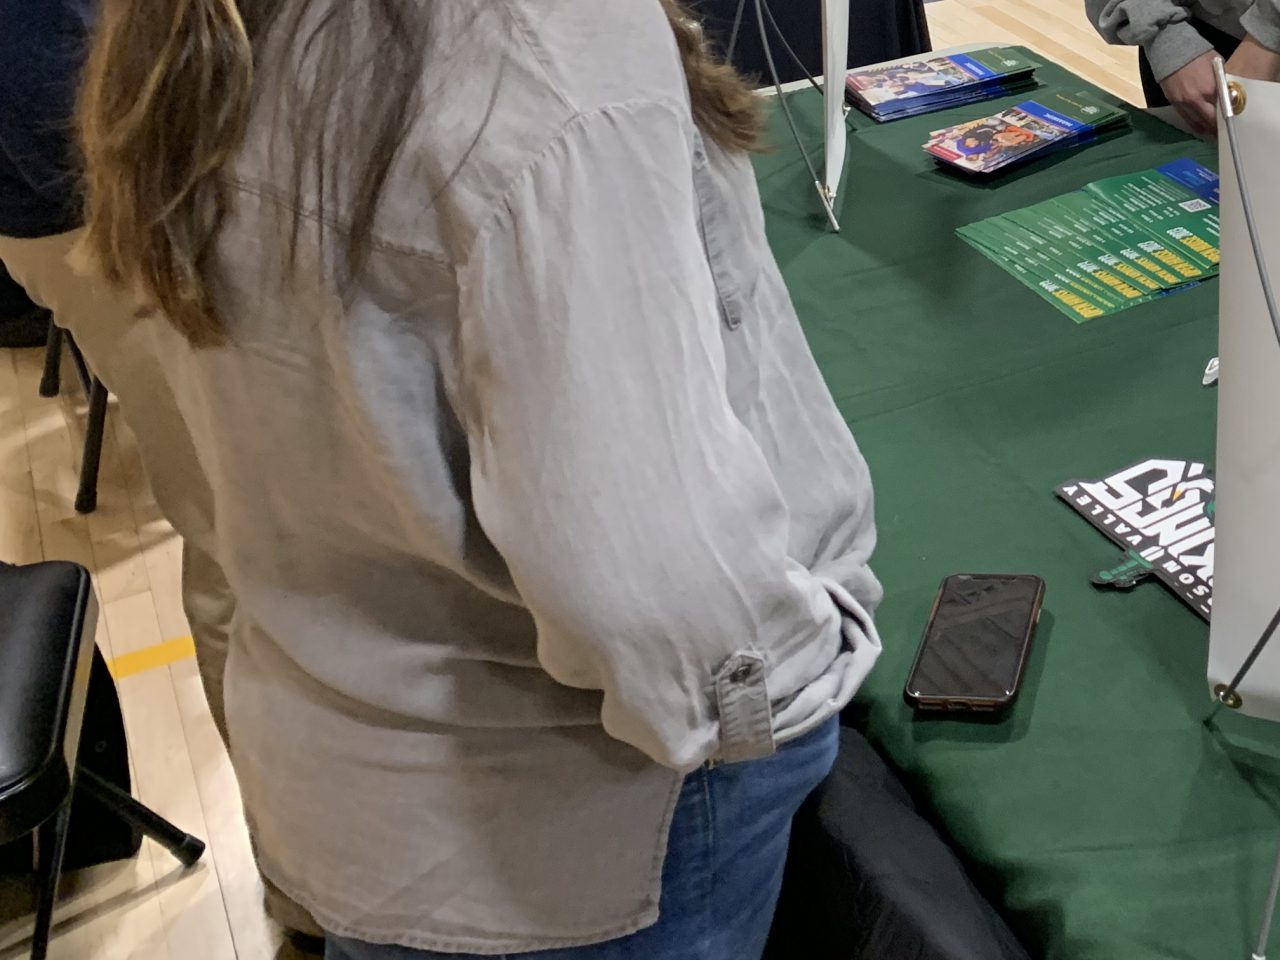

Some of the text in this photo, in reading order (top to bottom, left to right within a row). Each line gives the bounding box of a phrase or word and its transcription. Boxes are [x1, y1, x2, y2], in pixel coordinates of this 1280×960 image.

[1062, 486, 1213, 607] SON VALLEY
[1078, 459, 1216, 588] KINGS
